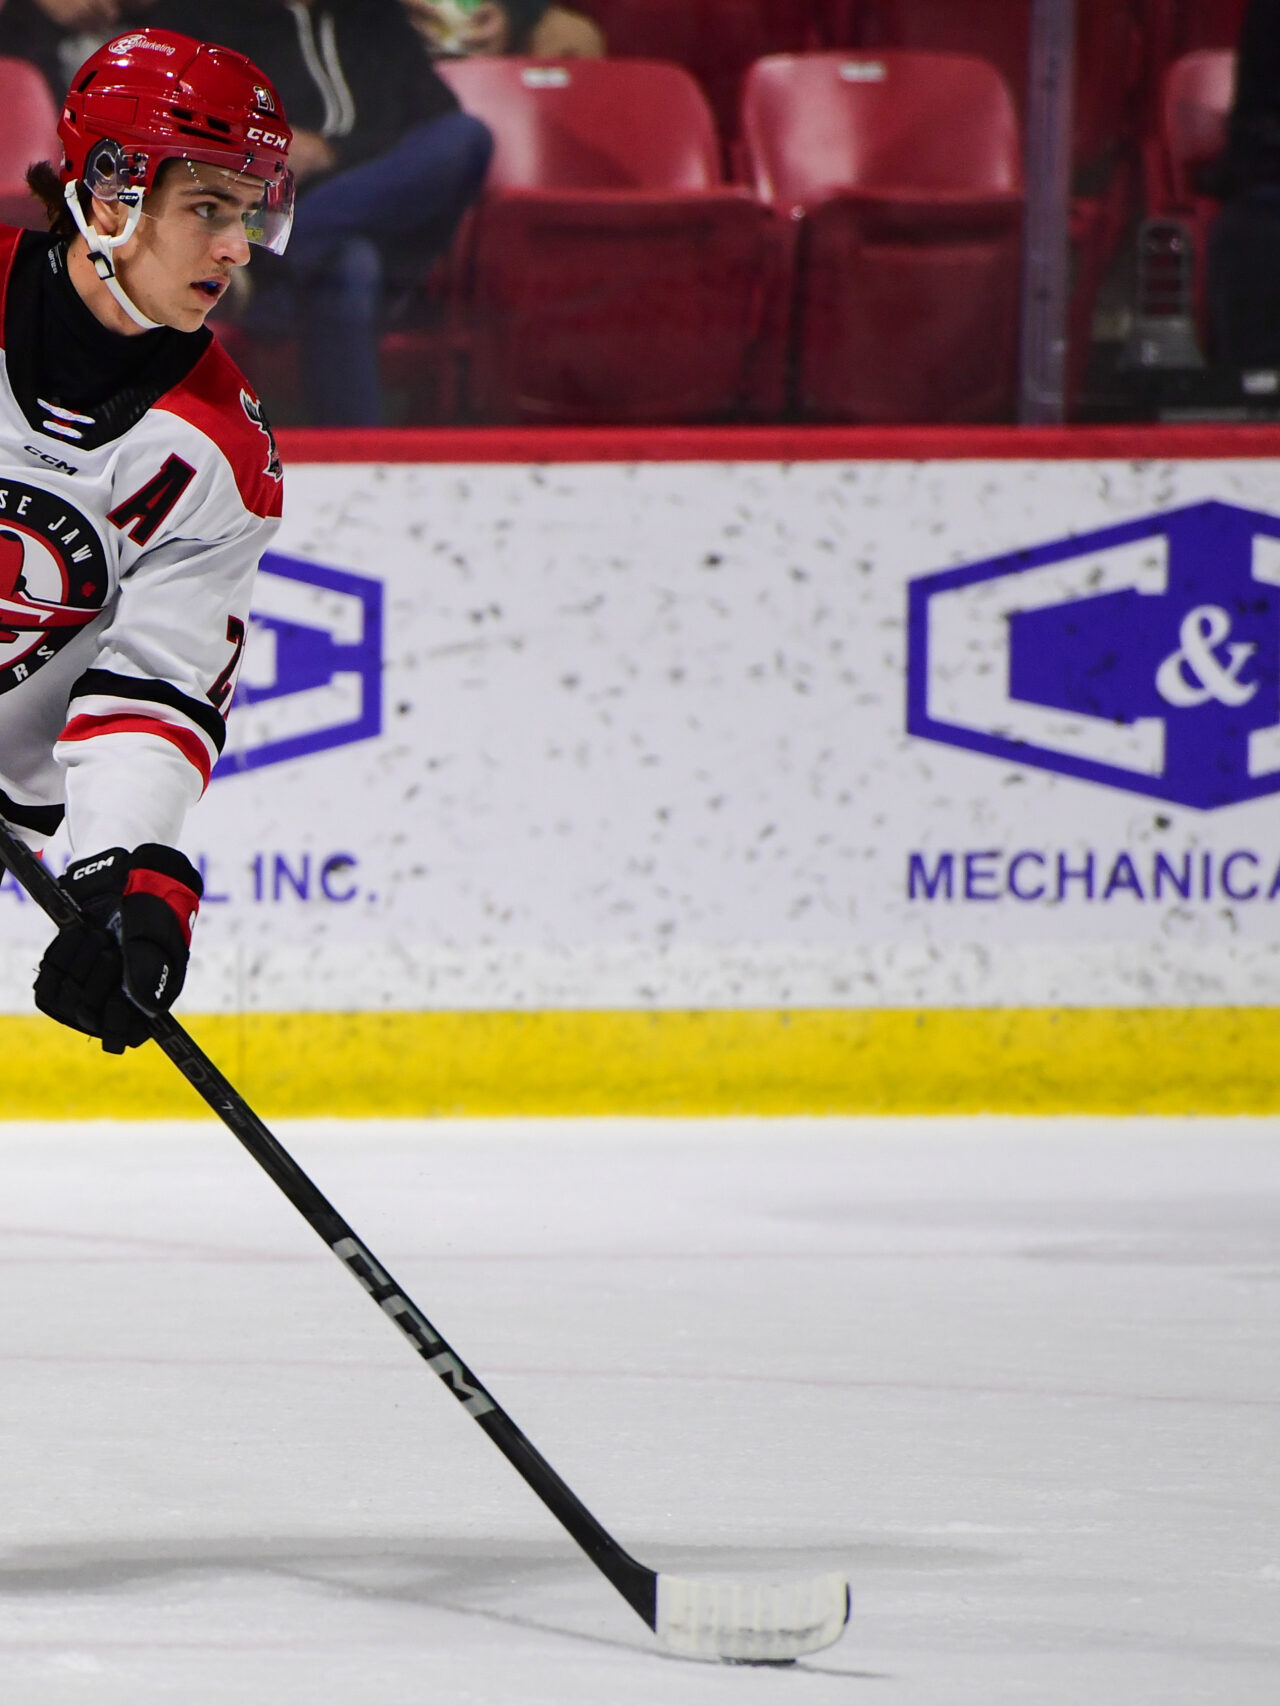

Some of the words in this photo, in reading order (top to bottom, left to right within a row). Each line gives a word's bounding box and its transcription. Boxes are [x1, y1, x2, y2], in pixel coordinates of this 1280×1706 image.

[253, 85, 275, 112] 21
[247, 126, 287, 149] CCM
[23, 445, 79, 476] CCM
[106, 452, 197, 548] A
[47, 515, 93, 564] JAW
[205, 614, 249, 721] 2
[73, 855, 115, 881] CCM
[253, 850, 378, 904] INC.
[154, 964, 170, 1000] CCM
[331, 1235, 497, 1418] CCM
